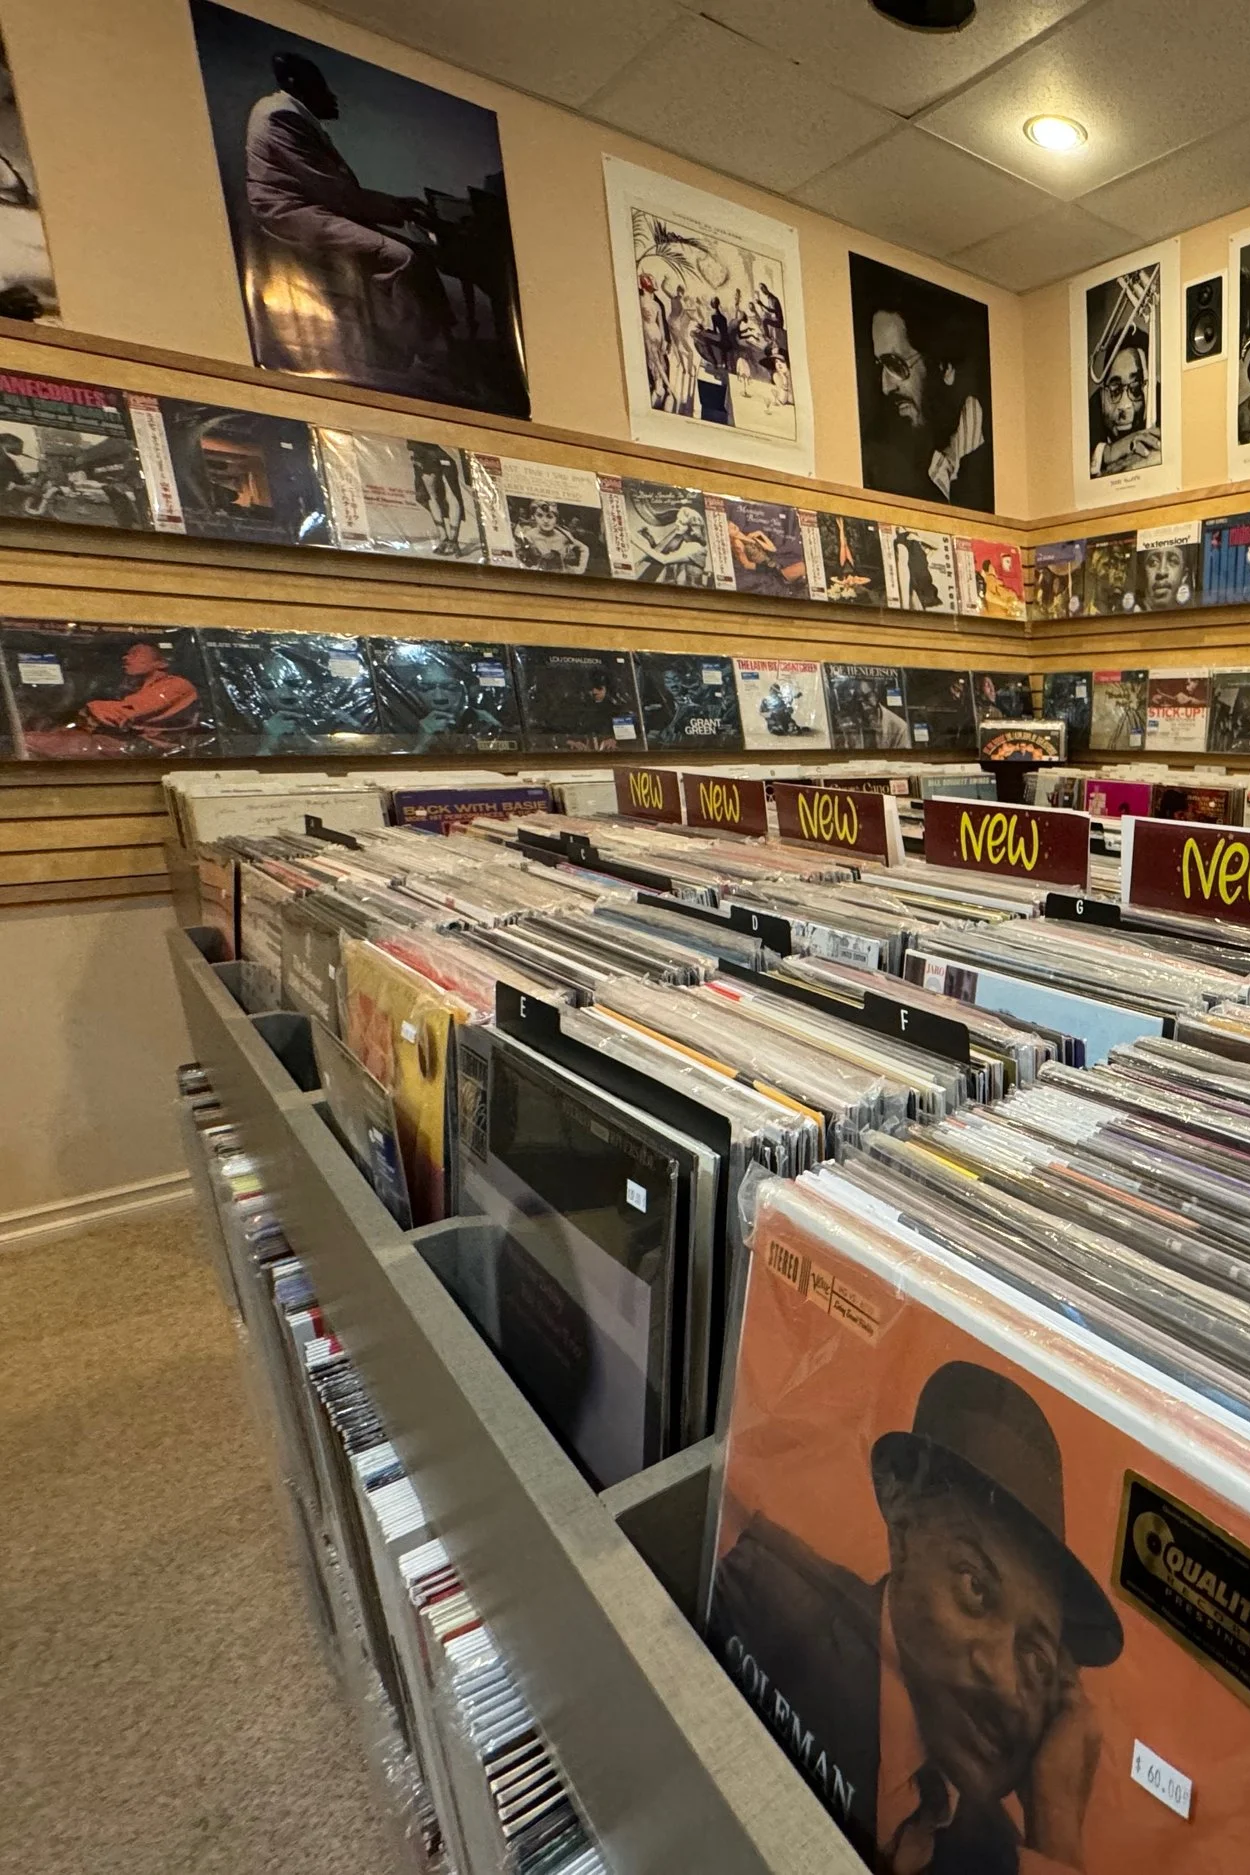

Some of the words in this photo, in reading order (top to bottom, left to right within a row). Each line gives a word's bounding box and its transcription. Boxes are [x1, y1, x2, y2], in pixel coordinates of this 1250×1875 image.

[737, 659, 749, 670] THE
[828, 664, 847, 676] JOE
[848, 666, 898, 677] HENDERSON
[1148, 706, 1206, 720] STICK-UP!
[685, 726, 717, 736] GREEN
[689, 718, 722, 728] GRANT
[629, 771, 663, 810] New
[403, 805, 450, 816] BACK
[454, 802, 498, 813] WITH
[502, 800, 548, 811] BASIE
[699, 781, 740, 824] New
[798, 793, 859, 845] New
[959, 811, 1039, 871] New
[580, 848, 586, 860] C
[1076, 899, 1084, 914] G
[751, 914, 759, 931] D
[926, 962, 945, 977] JARO
[520, 995, 527, 1018] E
[900, 1009, 909, 1031] F
[767, 1240, 801, 1285] STEREO
